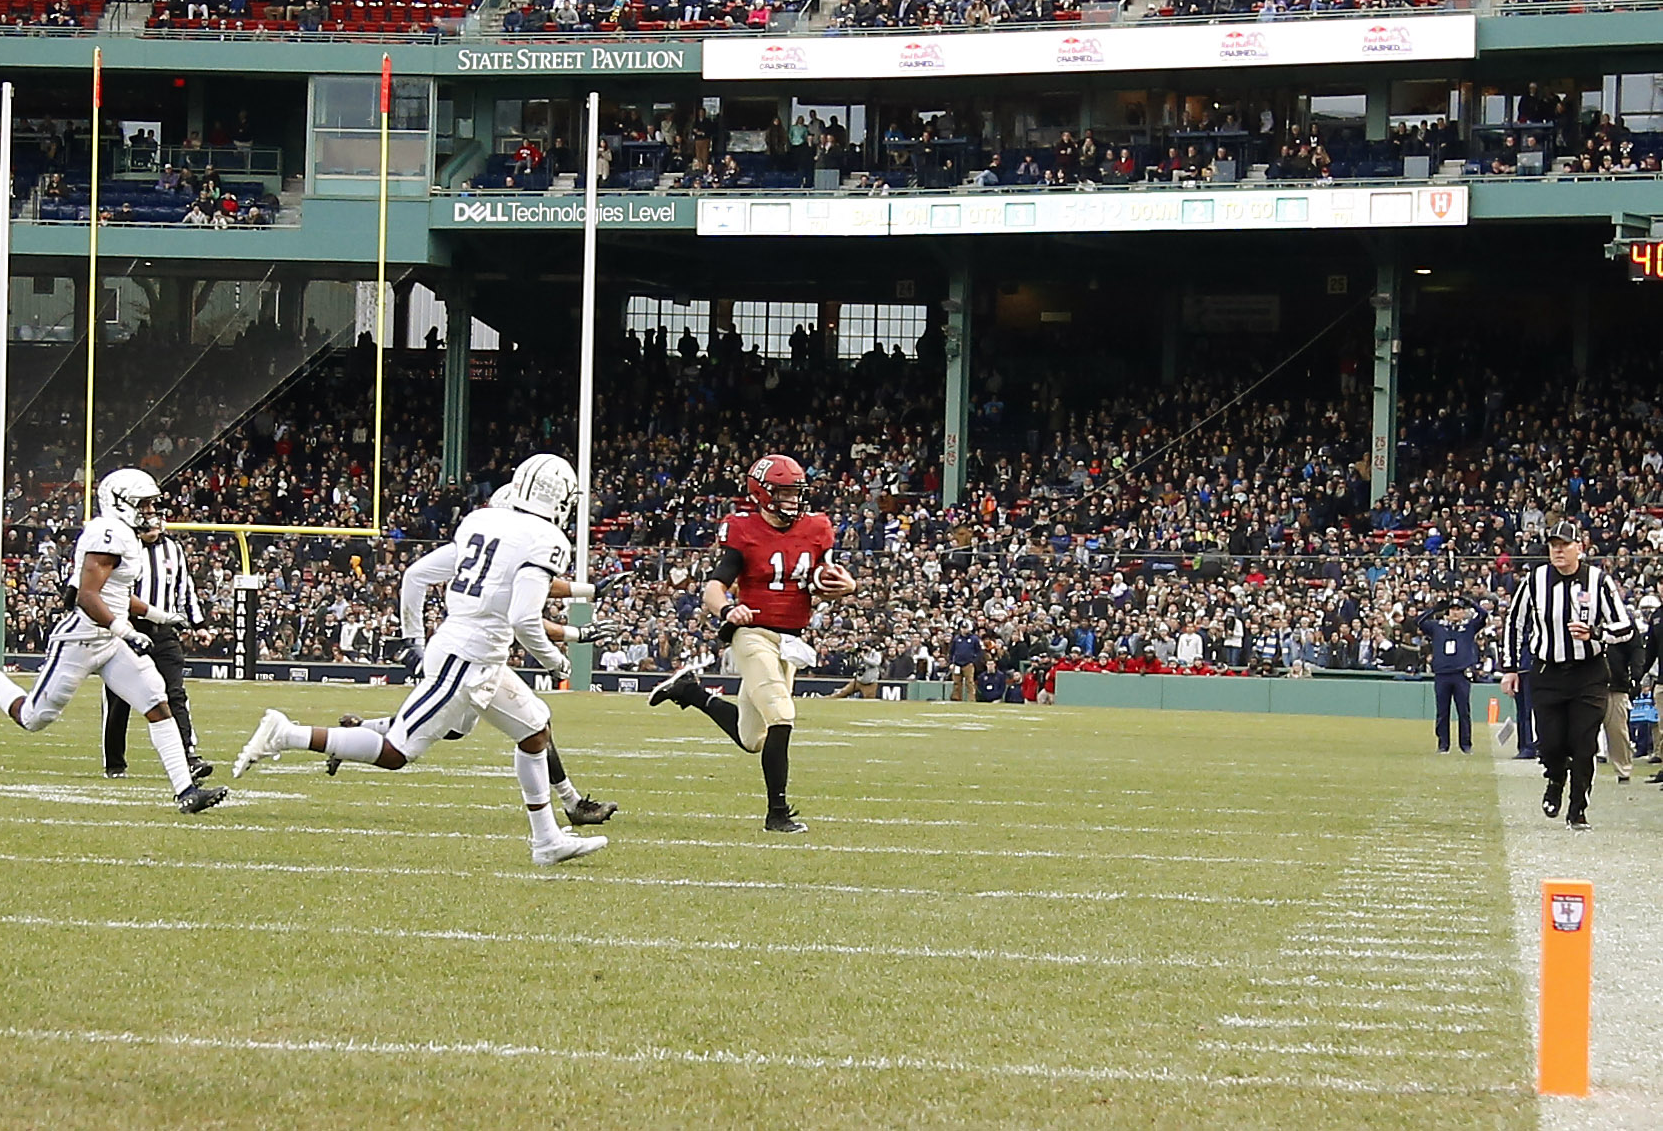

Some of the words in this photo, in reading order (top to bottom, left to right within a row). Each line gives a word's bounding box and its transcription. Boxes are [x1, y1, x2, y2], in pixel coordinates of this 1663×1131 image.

[457, 49, 513, 70] STATE
[516, 48, 585, 70] STREET
[591, 47, 684, 69] PAVILION
[454, 201, 508, 223] DELL
[628, 202, 675, 223] Level
[1129, 202, 1179, 221] DOWN
[1249, 201, 1274, 219] GO
[1330, 277, 1345, 291] 25
[1375, 436, 1386, 447] 25
[1374, 455, 1385, 467] 26
[104, 529, 114, 544] 5
[450, 533, 501, 598] 21
[549, 545, 565, 569] 21
[768, 551, 811, 591] 14
[235, 590, 247, 680] HARVARD
[212, 666, 228, 678] M
[535, 675, 552, 691] M
[882, 686, 901, 701] M
